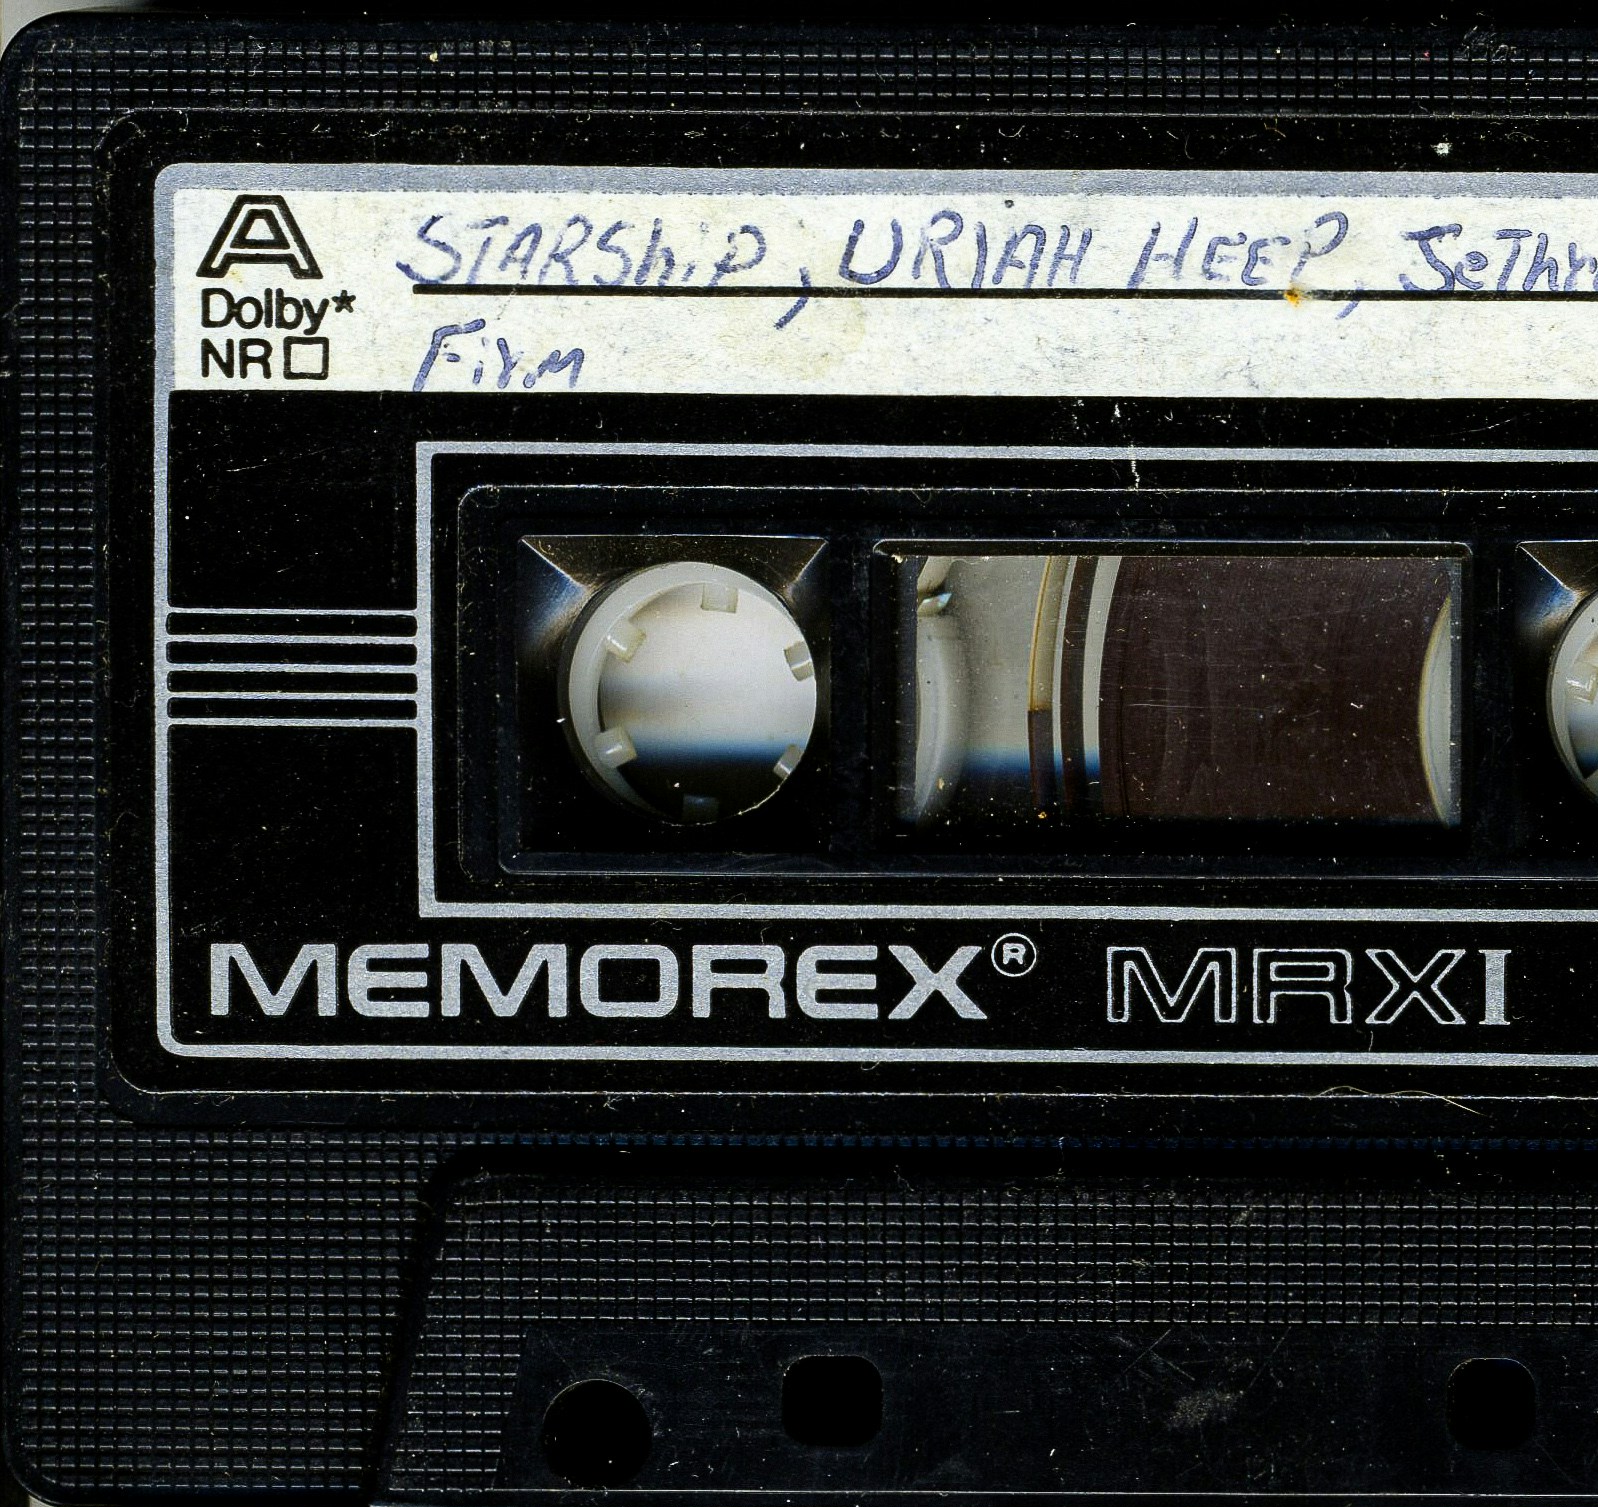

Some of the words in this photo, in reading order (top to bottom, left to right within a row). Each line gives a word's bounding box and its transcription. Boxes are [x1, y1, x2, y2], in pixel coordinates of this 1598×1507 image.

[197, 194, 322, 279] A
[841, 210, 1084, 291] URIAH
[201, 339, 270, 378] NR
